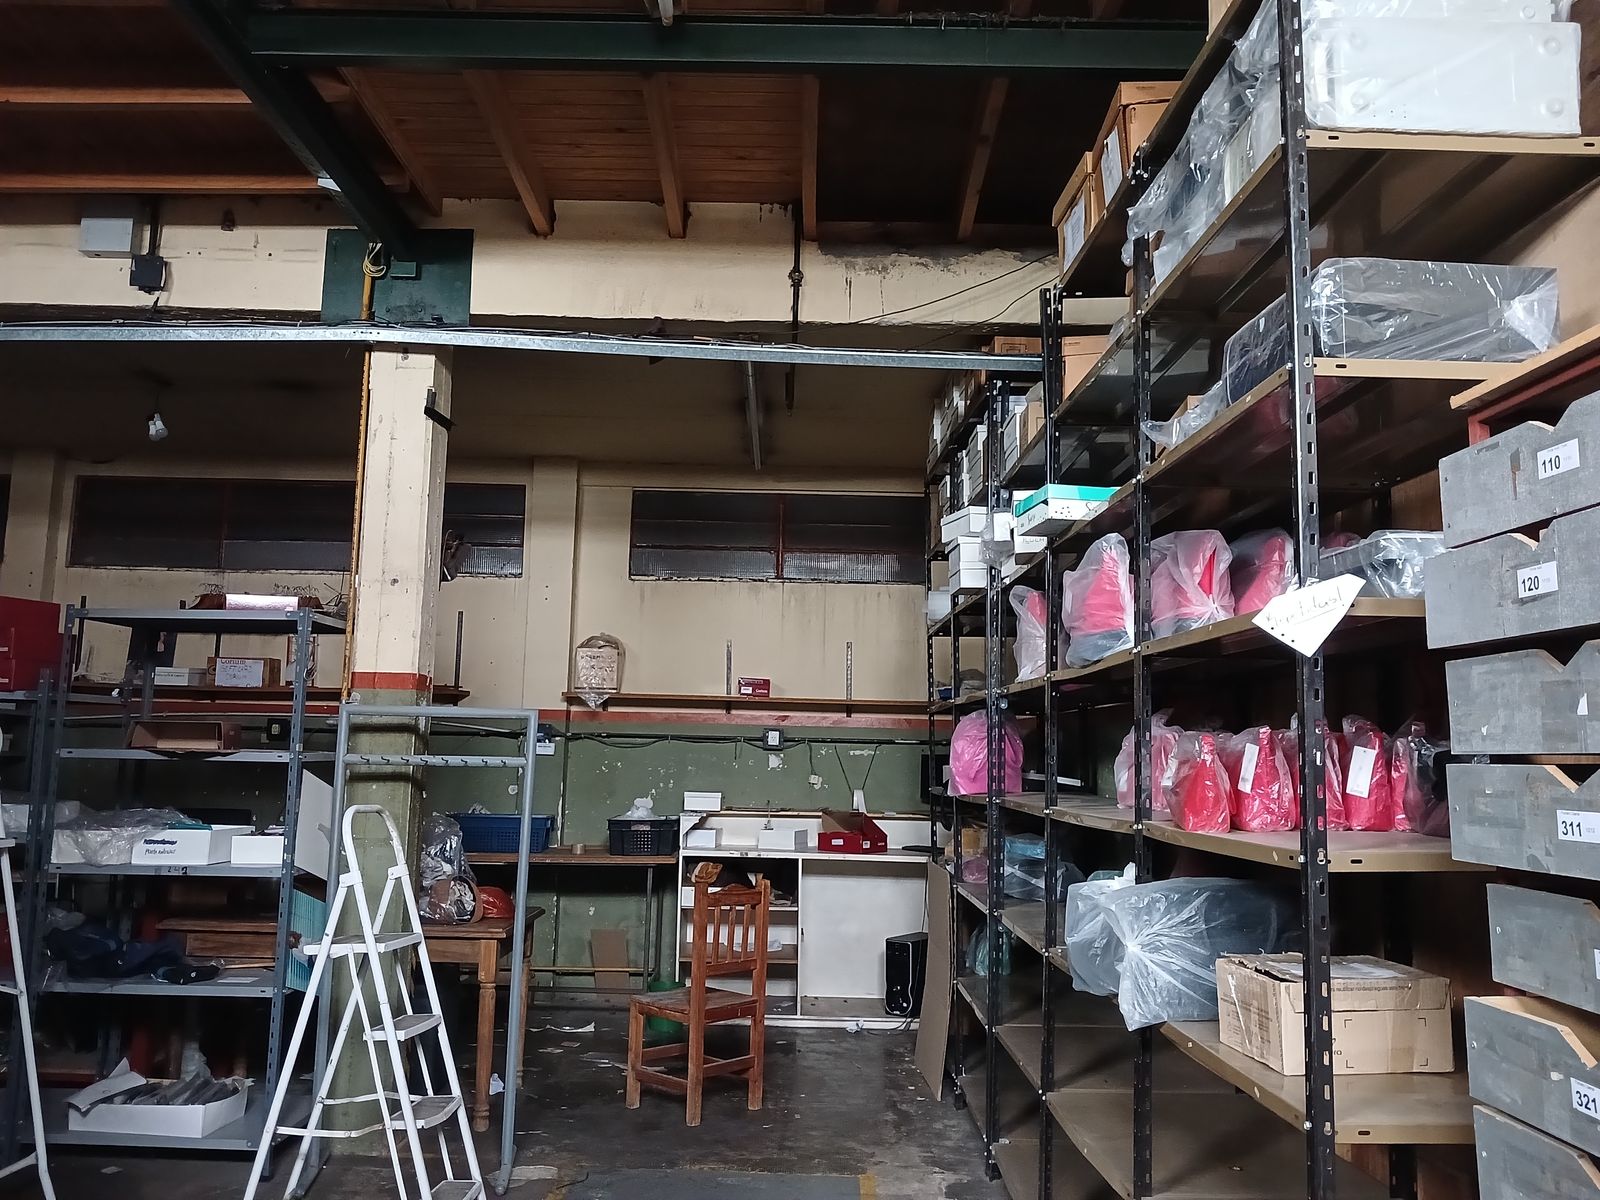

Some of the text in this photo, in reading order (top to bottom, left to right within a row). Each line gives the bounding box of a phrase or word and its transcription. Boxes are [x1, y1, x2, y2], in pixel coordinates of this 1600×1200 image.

[1542, 455, 1560, 474] 110
[1521, 575, 1540, 593] 120
[1561, 820, 1582, 837] 311
[1575, 1090, 1598, 1114] 321
